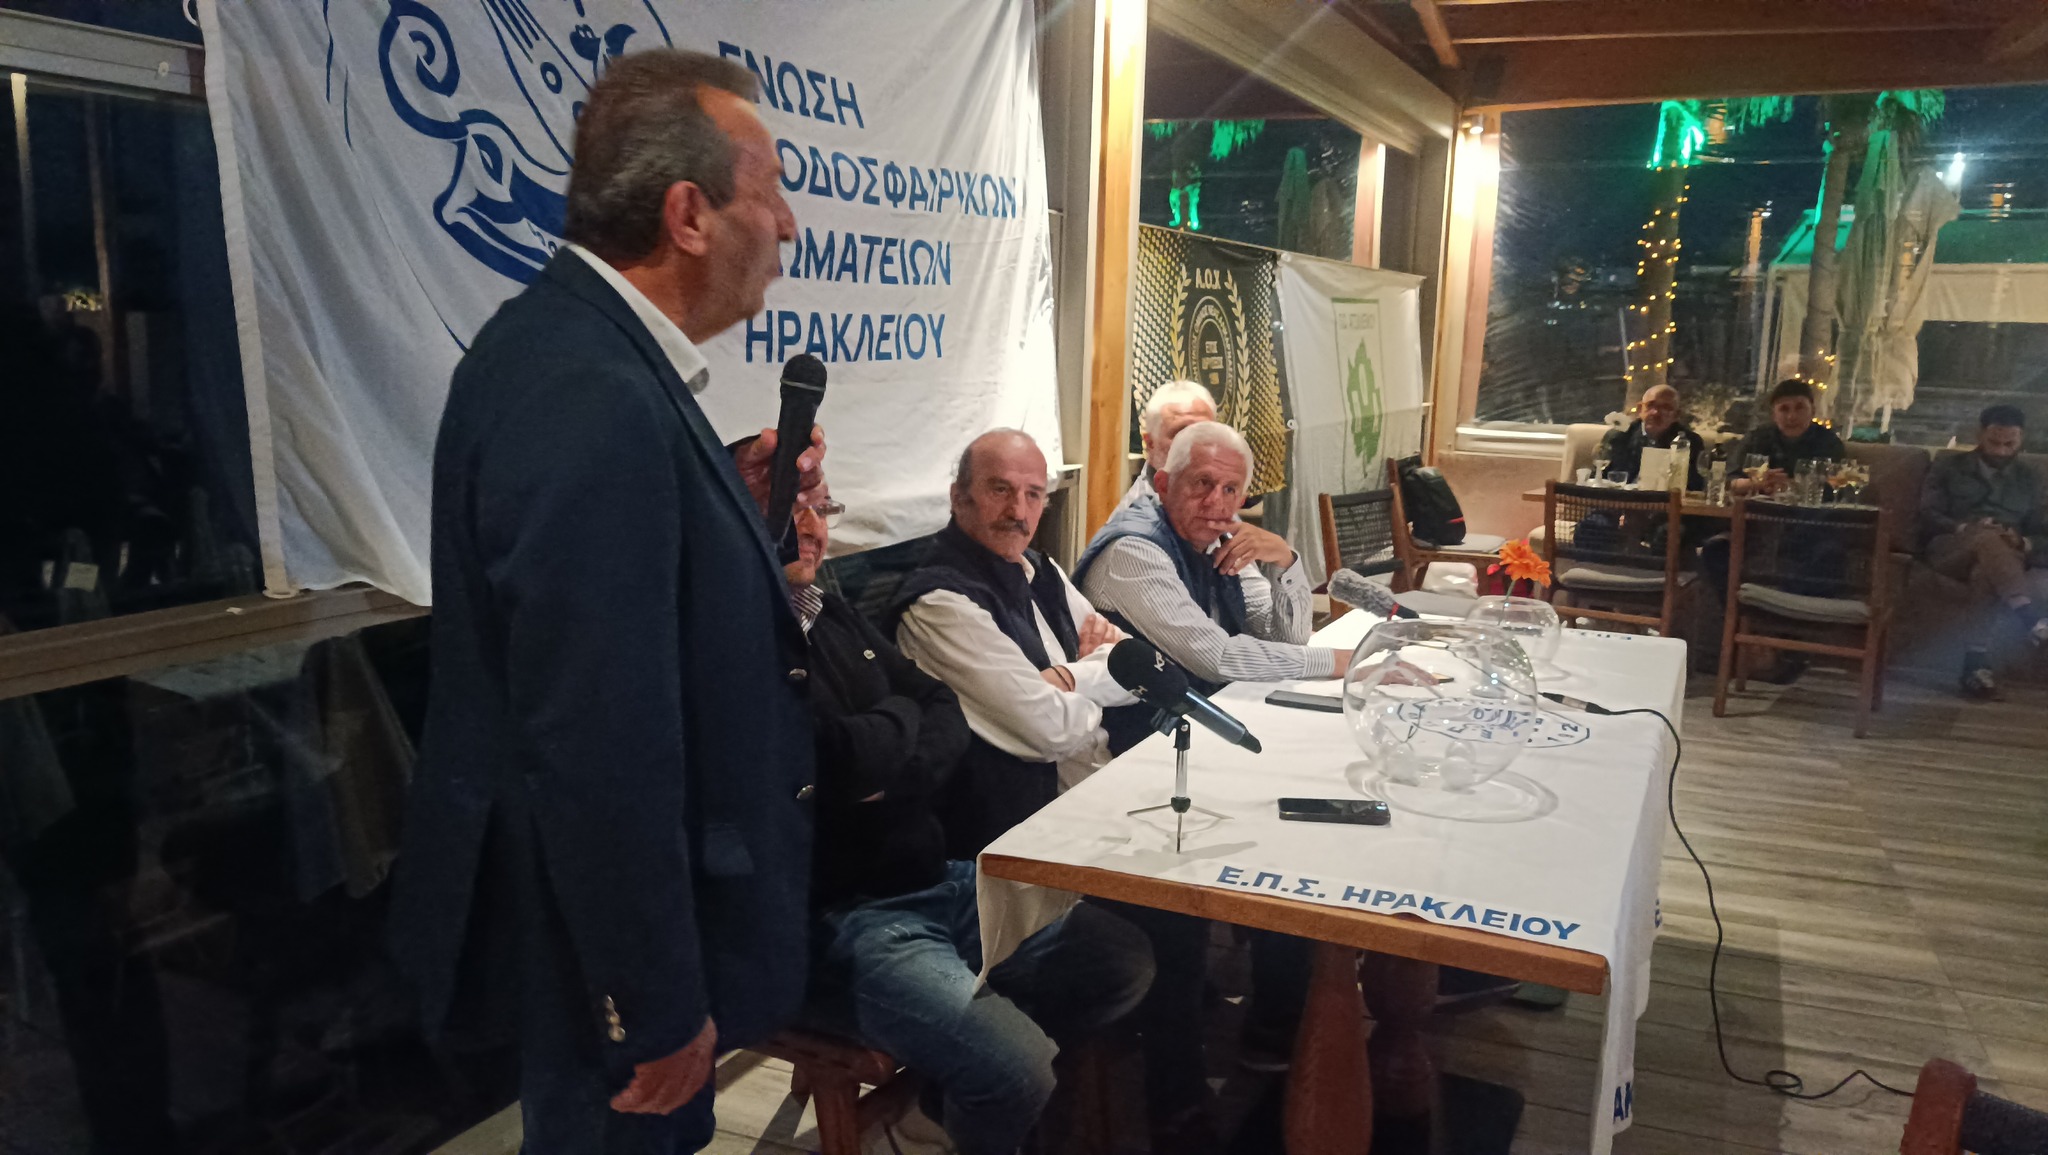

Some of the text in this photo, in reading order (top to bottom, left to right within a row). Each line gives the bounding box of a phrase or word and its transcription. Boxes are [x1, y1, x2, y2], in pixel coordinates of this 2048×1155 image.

[775, 138, 1017, 219] ΟΔΟΣΦΑΙΡΙΚΩΝ
[778, 227, 951, 286] ΩΜΑΤΕΙΩΝ
[745, 309, 946, 363] ΗΡΑΚΛΕΙΟΥ
[1216, 865, 1581, 940] Ε.Π.Σ. ΗΡΑΚΛΕΙΟΥ
